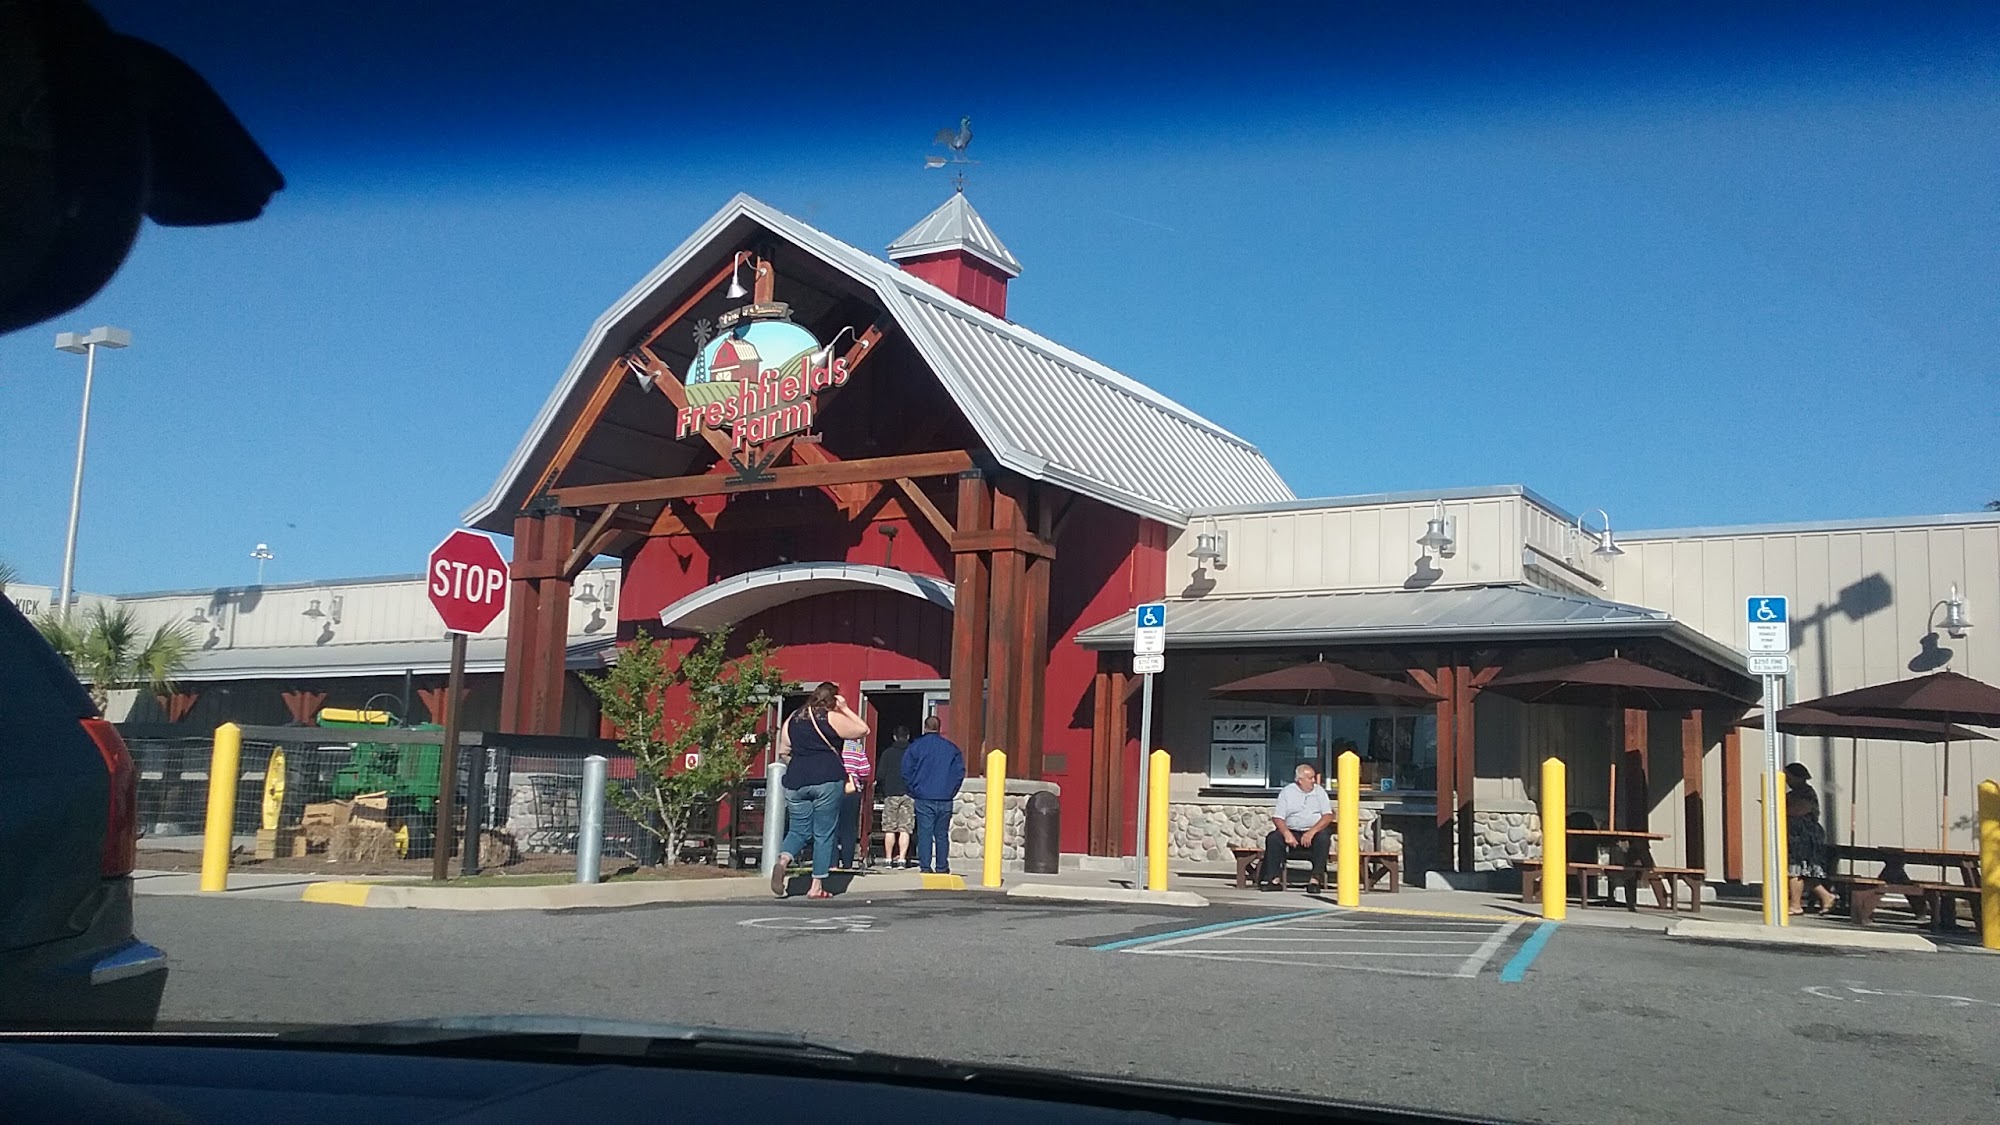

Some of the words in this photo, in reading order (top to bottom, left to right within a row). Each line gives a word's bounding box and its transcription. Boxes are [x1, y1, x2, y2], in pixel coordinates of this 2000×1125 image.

[677, 347, 849, 439] Freshfields
[732, 401, 812, 451] Farm
[432, 559, 503, 604] STOP
